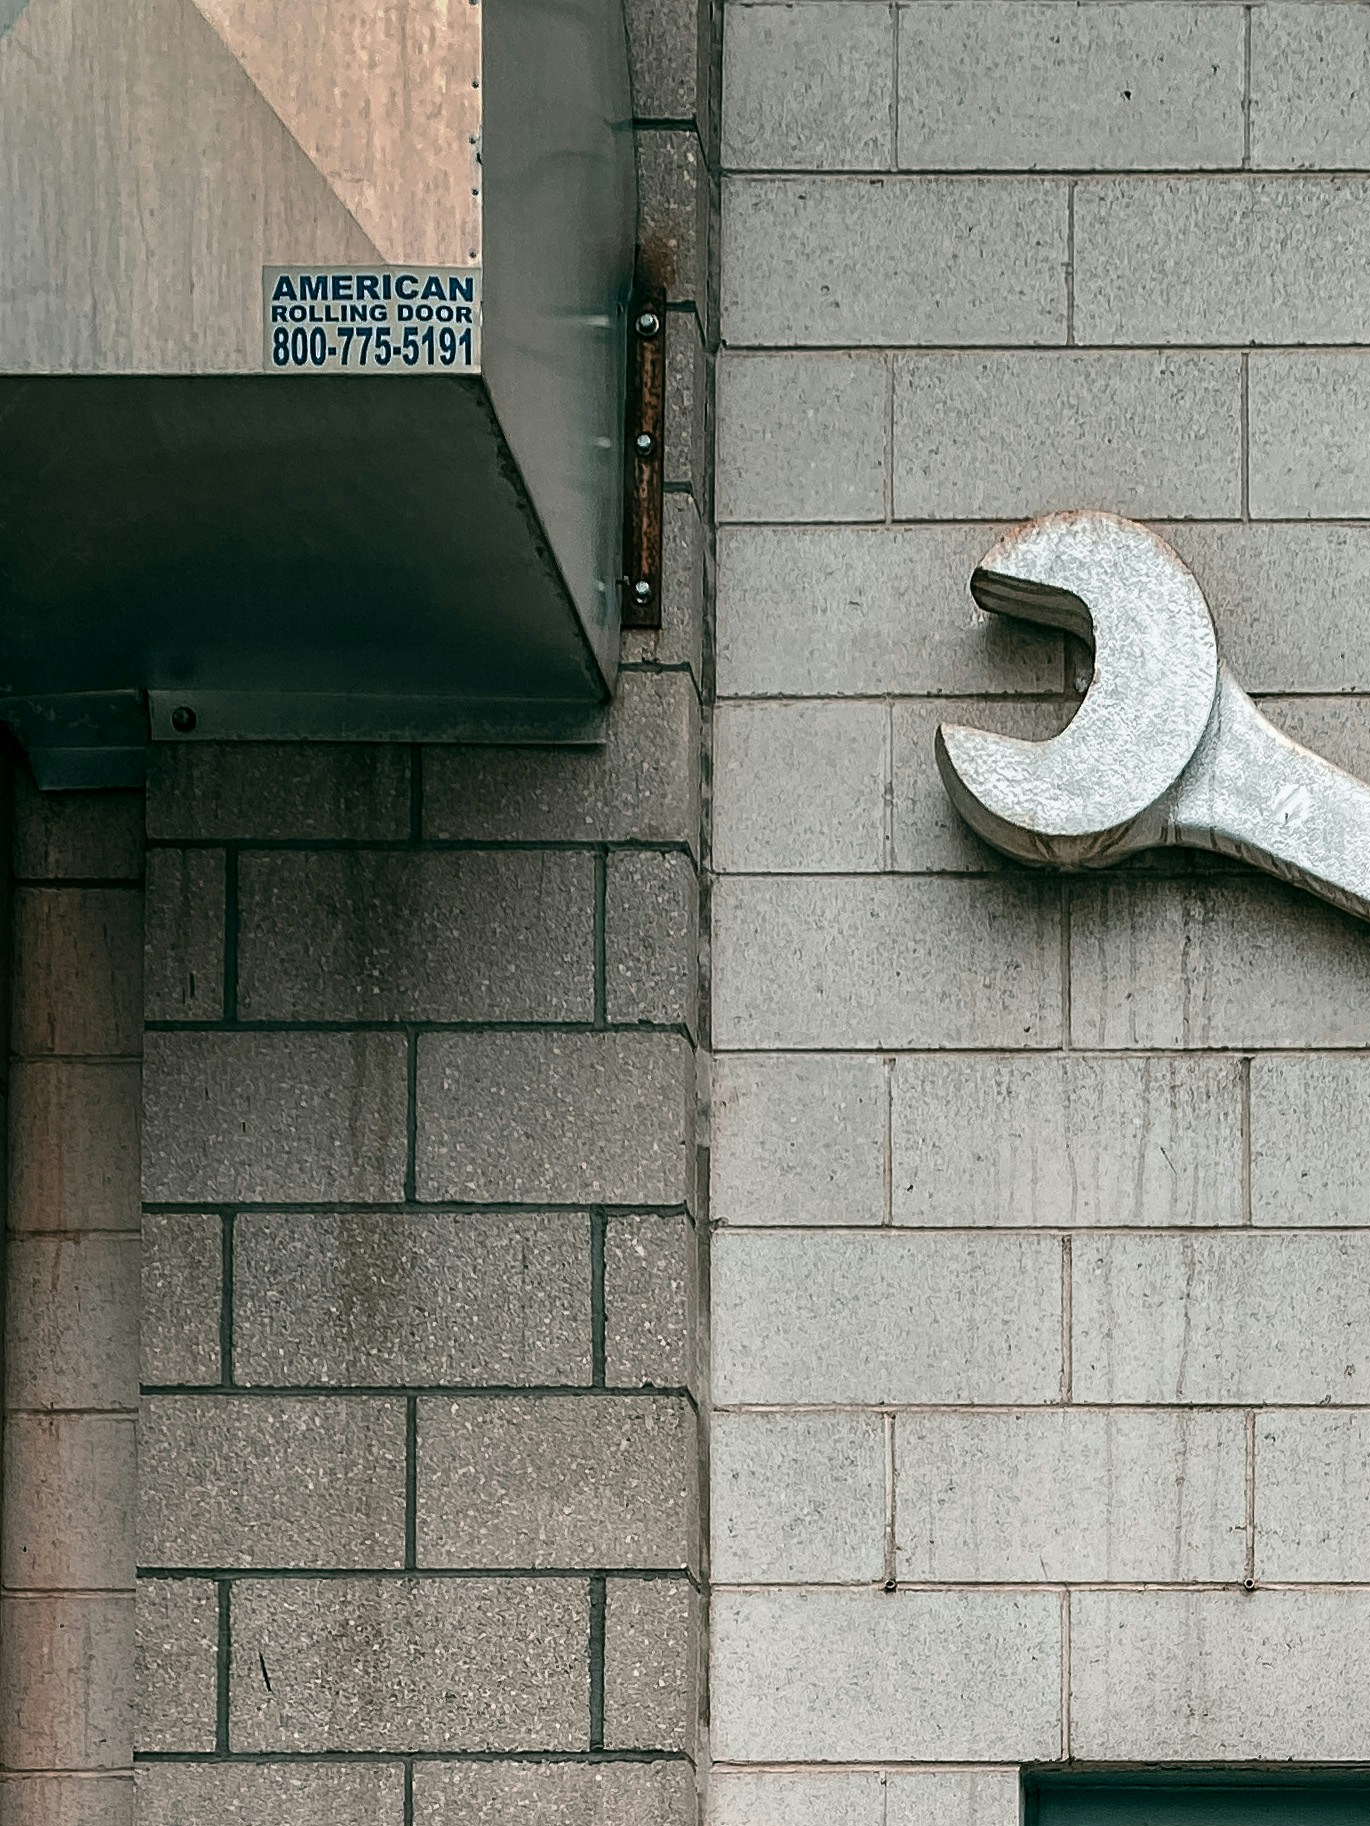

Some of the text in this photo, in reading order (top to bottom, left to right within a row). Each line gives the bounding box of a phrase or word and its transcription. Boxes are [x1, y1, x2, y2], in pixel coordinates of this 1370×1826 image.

[272, 274, 474, 302] AMERICAN
[271, 304, 473, 323] ROLLING DOOR
[273, 326, 472, 366] 800-775-5191
